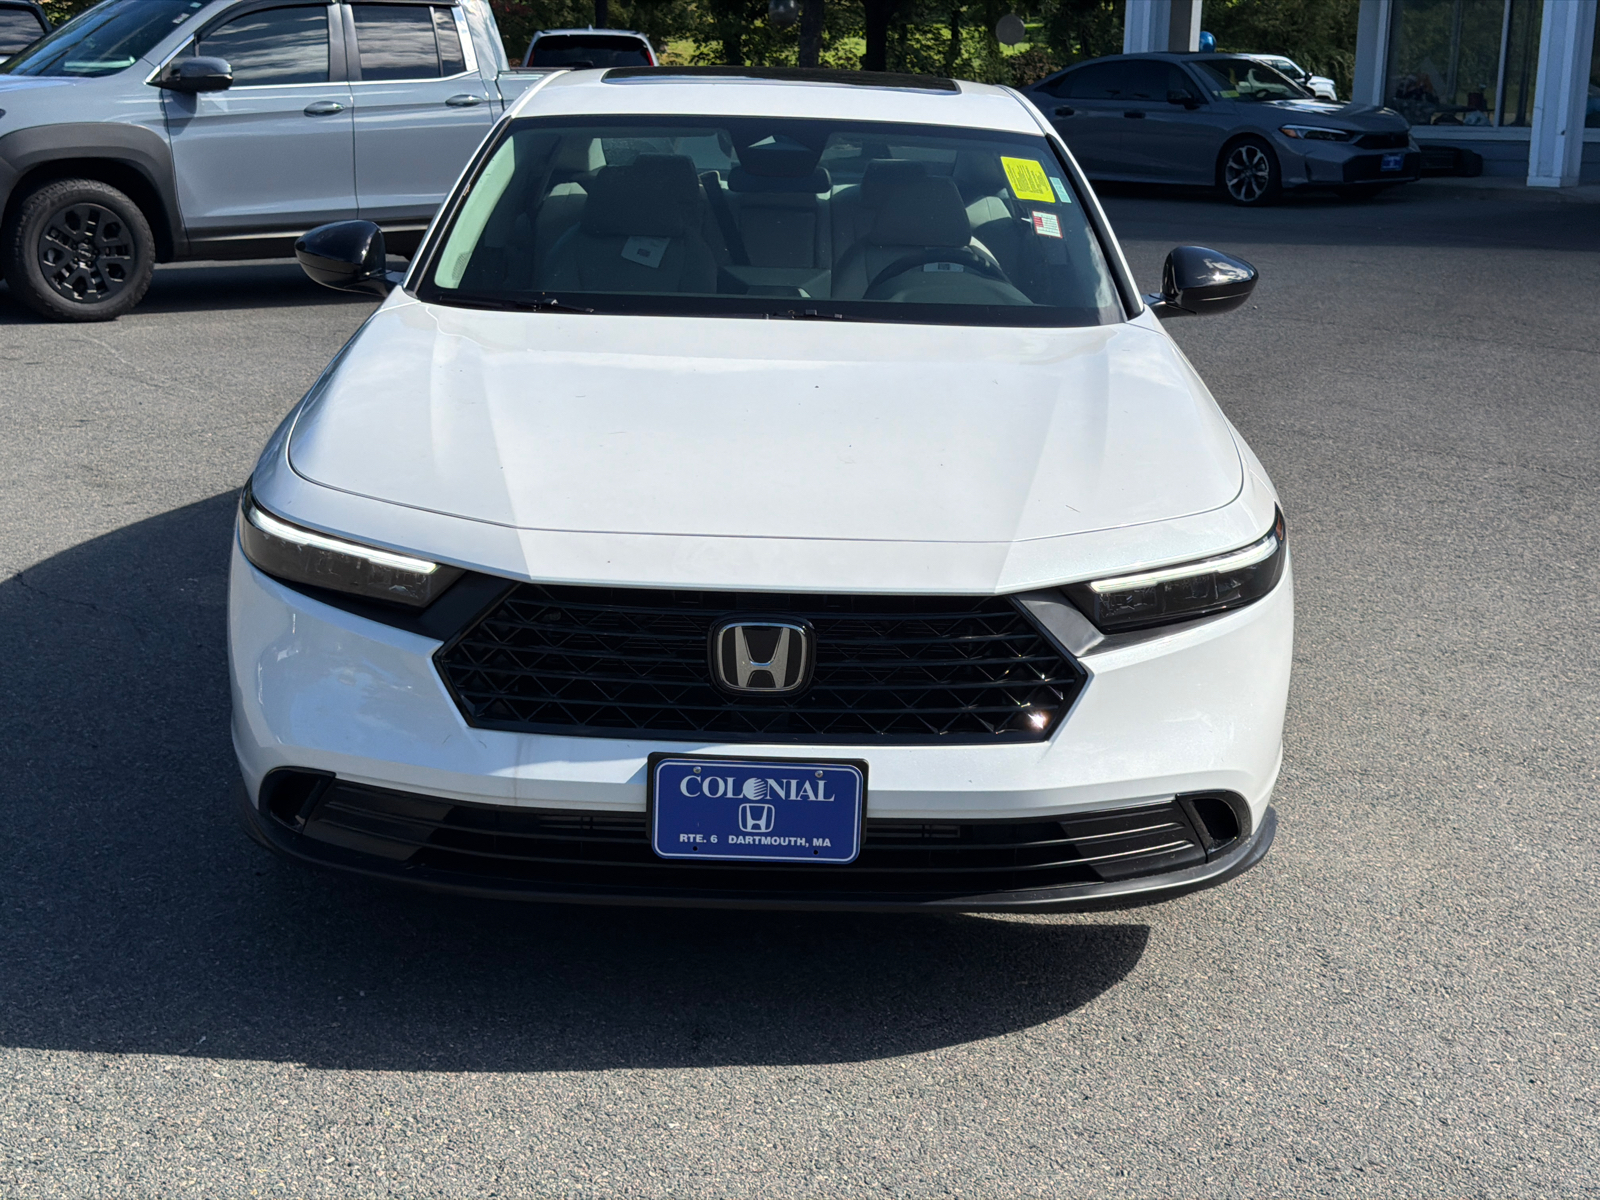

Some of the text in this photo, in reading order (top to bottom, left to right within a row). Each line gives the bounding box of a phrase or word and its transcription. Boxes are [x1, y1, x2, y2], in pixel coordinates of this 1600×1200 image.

[680, 775, 835, 802] COLONIAL
[679, 834, 832, 848] RTE. 6 DARTMOUTH, MA
